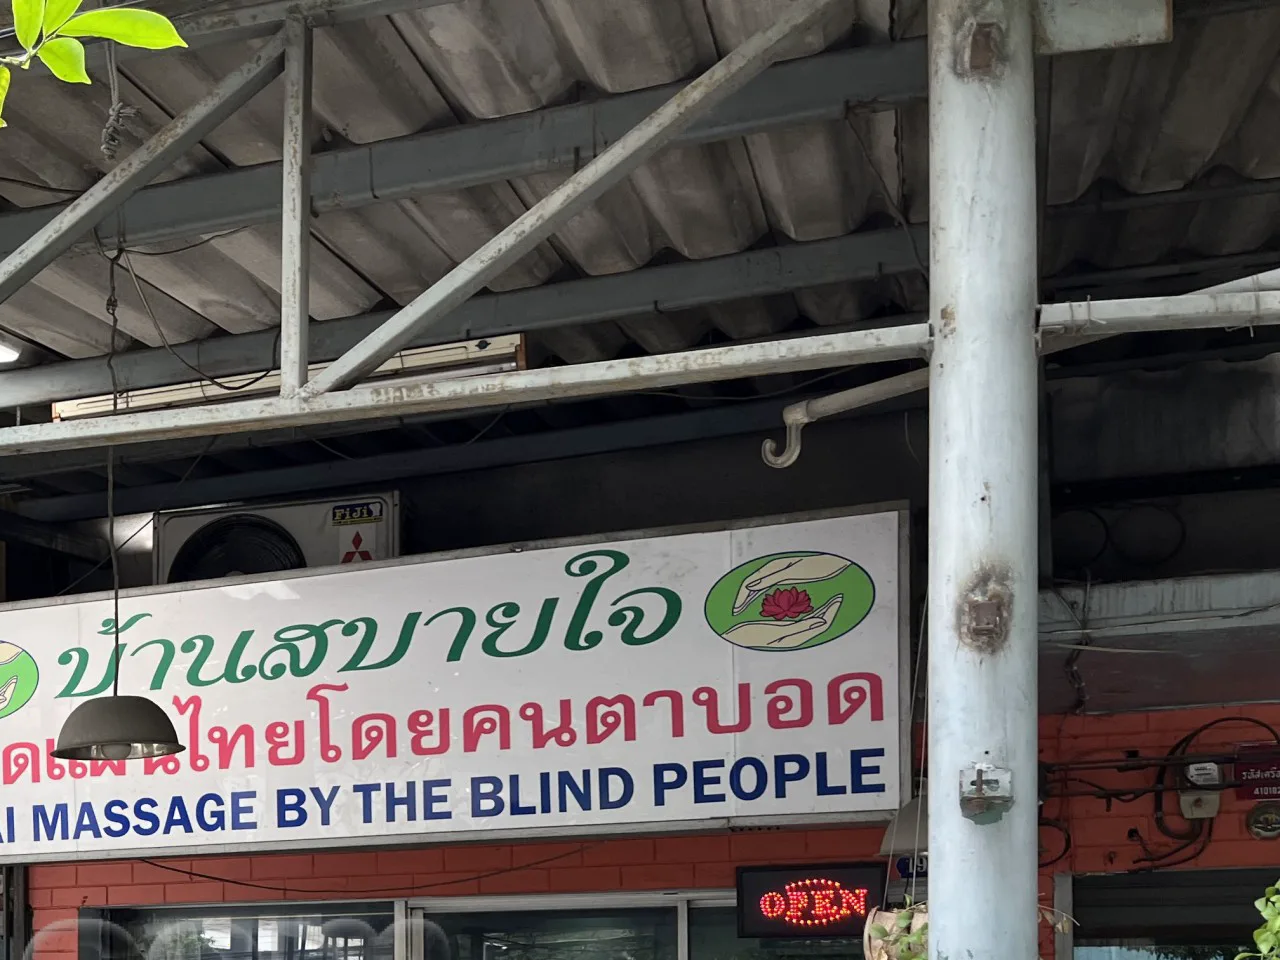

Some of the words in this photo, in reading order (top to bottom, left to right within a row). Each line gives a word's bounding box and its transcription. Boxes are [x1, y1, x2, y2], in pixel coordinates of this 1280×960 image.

[55, 549, 683, 699] บ้านสบายใจ
[32, 790, 258, 842] MASSAGE
[276, 785, 341, 831] BY
[353, 778, 452, 824] THE
[470, 766, 635, 820] BLIND
[653, 748, 886, 807] PEOPLE
[759, 889, 868, 918] OPEN
